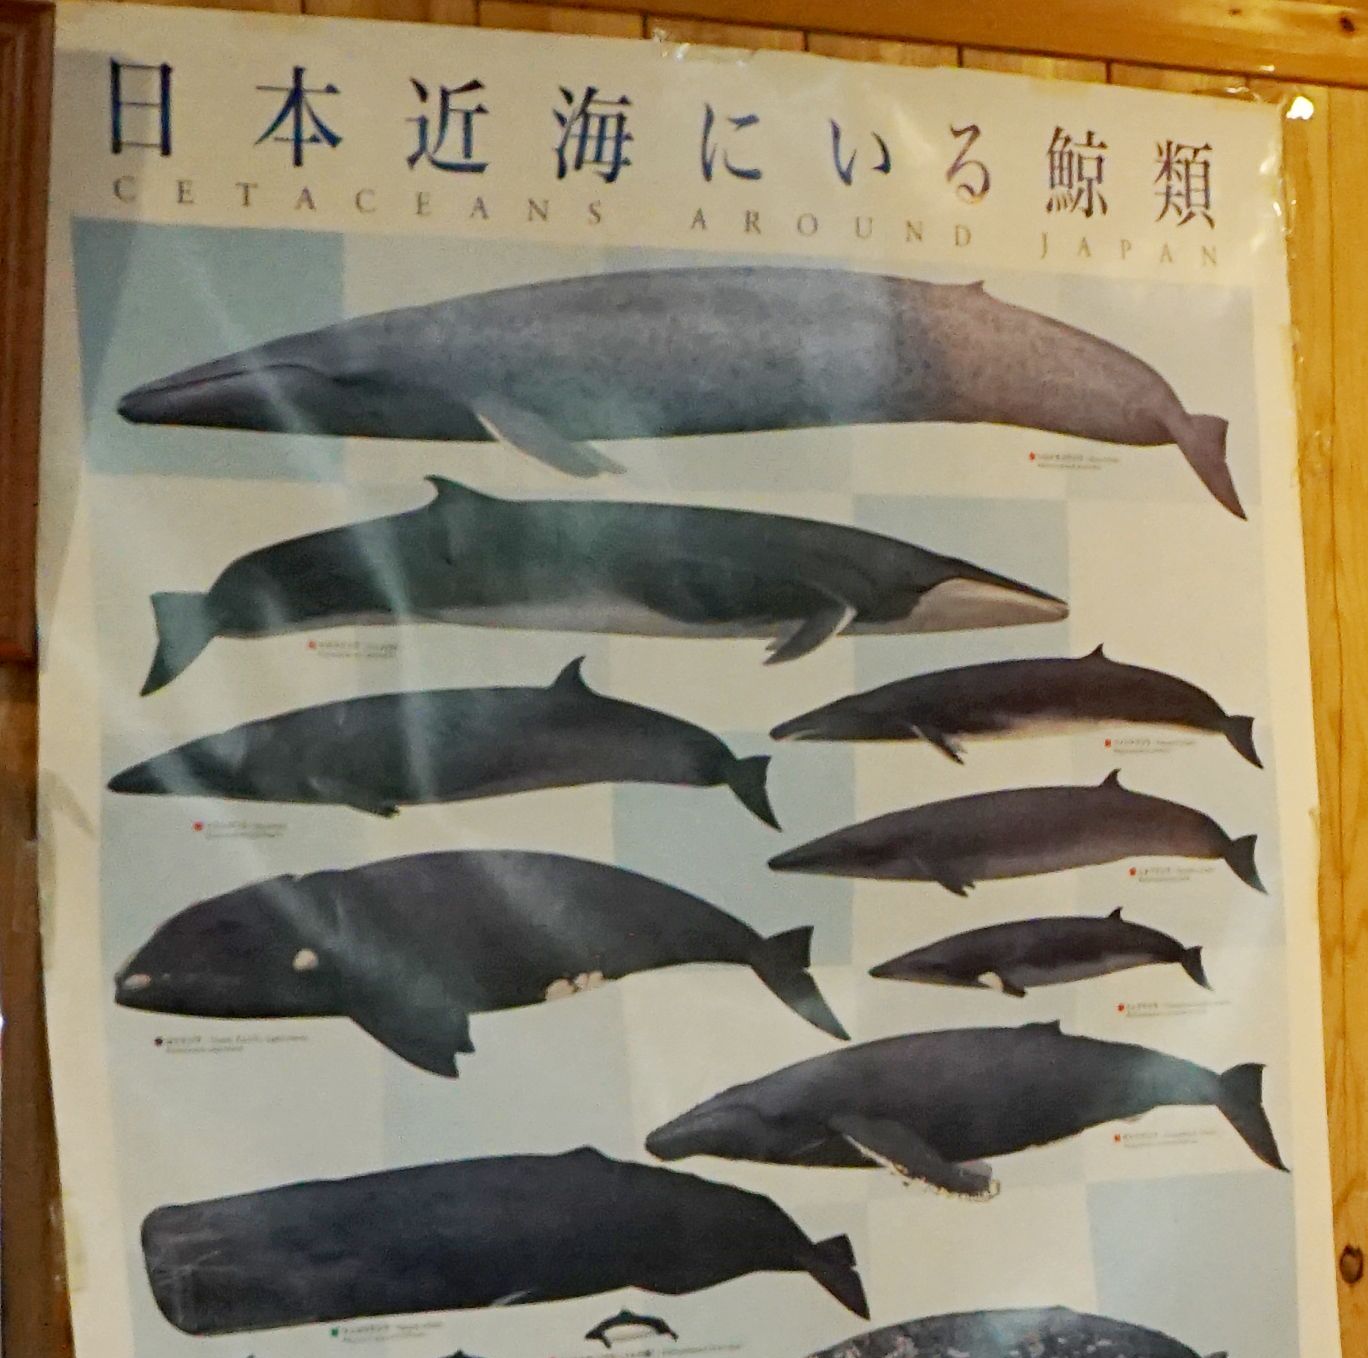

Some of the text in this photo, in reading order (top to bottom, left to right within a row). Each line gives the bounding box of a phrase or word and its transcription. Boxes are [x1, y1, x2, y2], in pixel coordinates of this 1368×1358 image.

[109, 57, 1216, 231] 日本近海にいる鯨類
[113, 174, 1219, 267] CETACEANS AROUND JAPAN
